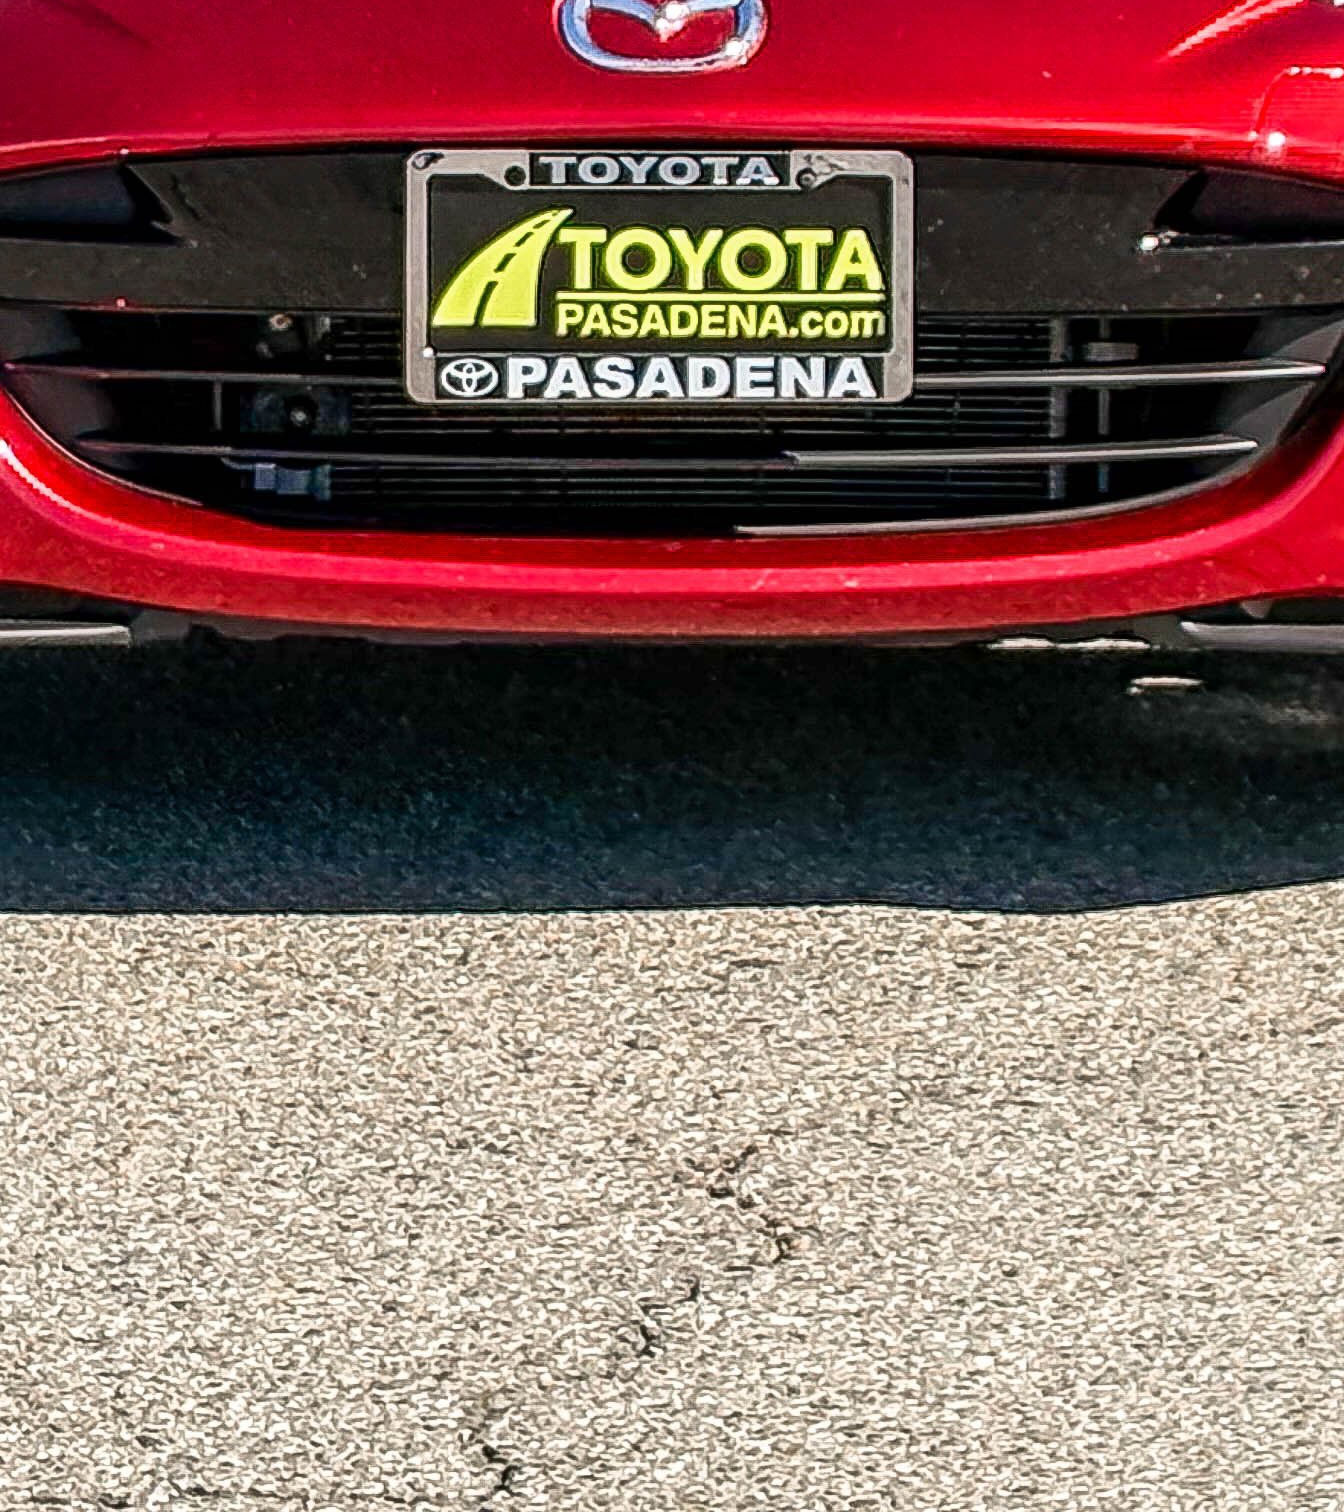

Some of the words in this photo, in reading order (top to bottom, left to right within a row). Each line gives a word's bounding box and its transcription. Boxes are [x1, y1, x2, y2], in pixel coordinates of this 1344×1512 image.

[540, 156, 779, 185] TOYOTA
[558, 227, 886, 292] TOYOTA
[557, 301, 886, 339] PASADENA.com
[506, 356, 878, 399] PASADENA
